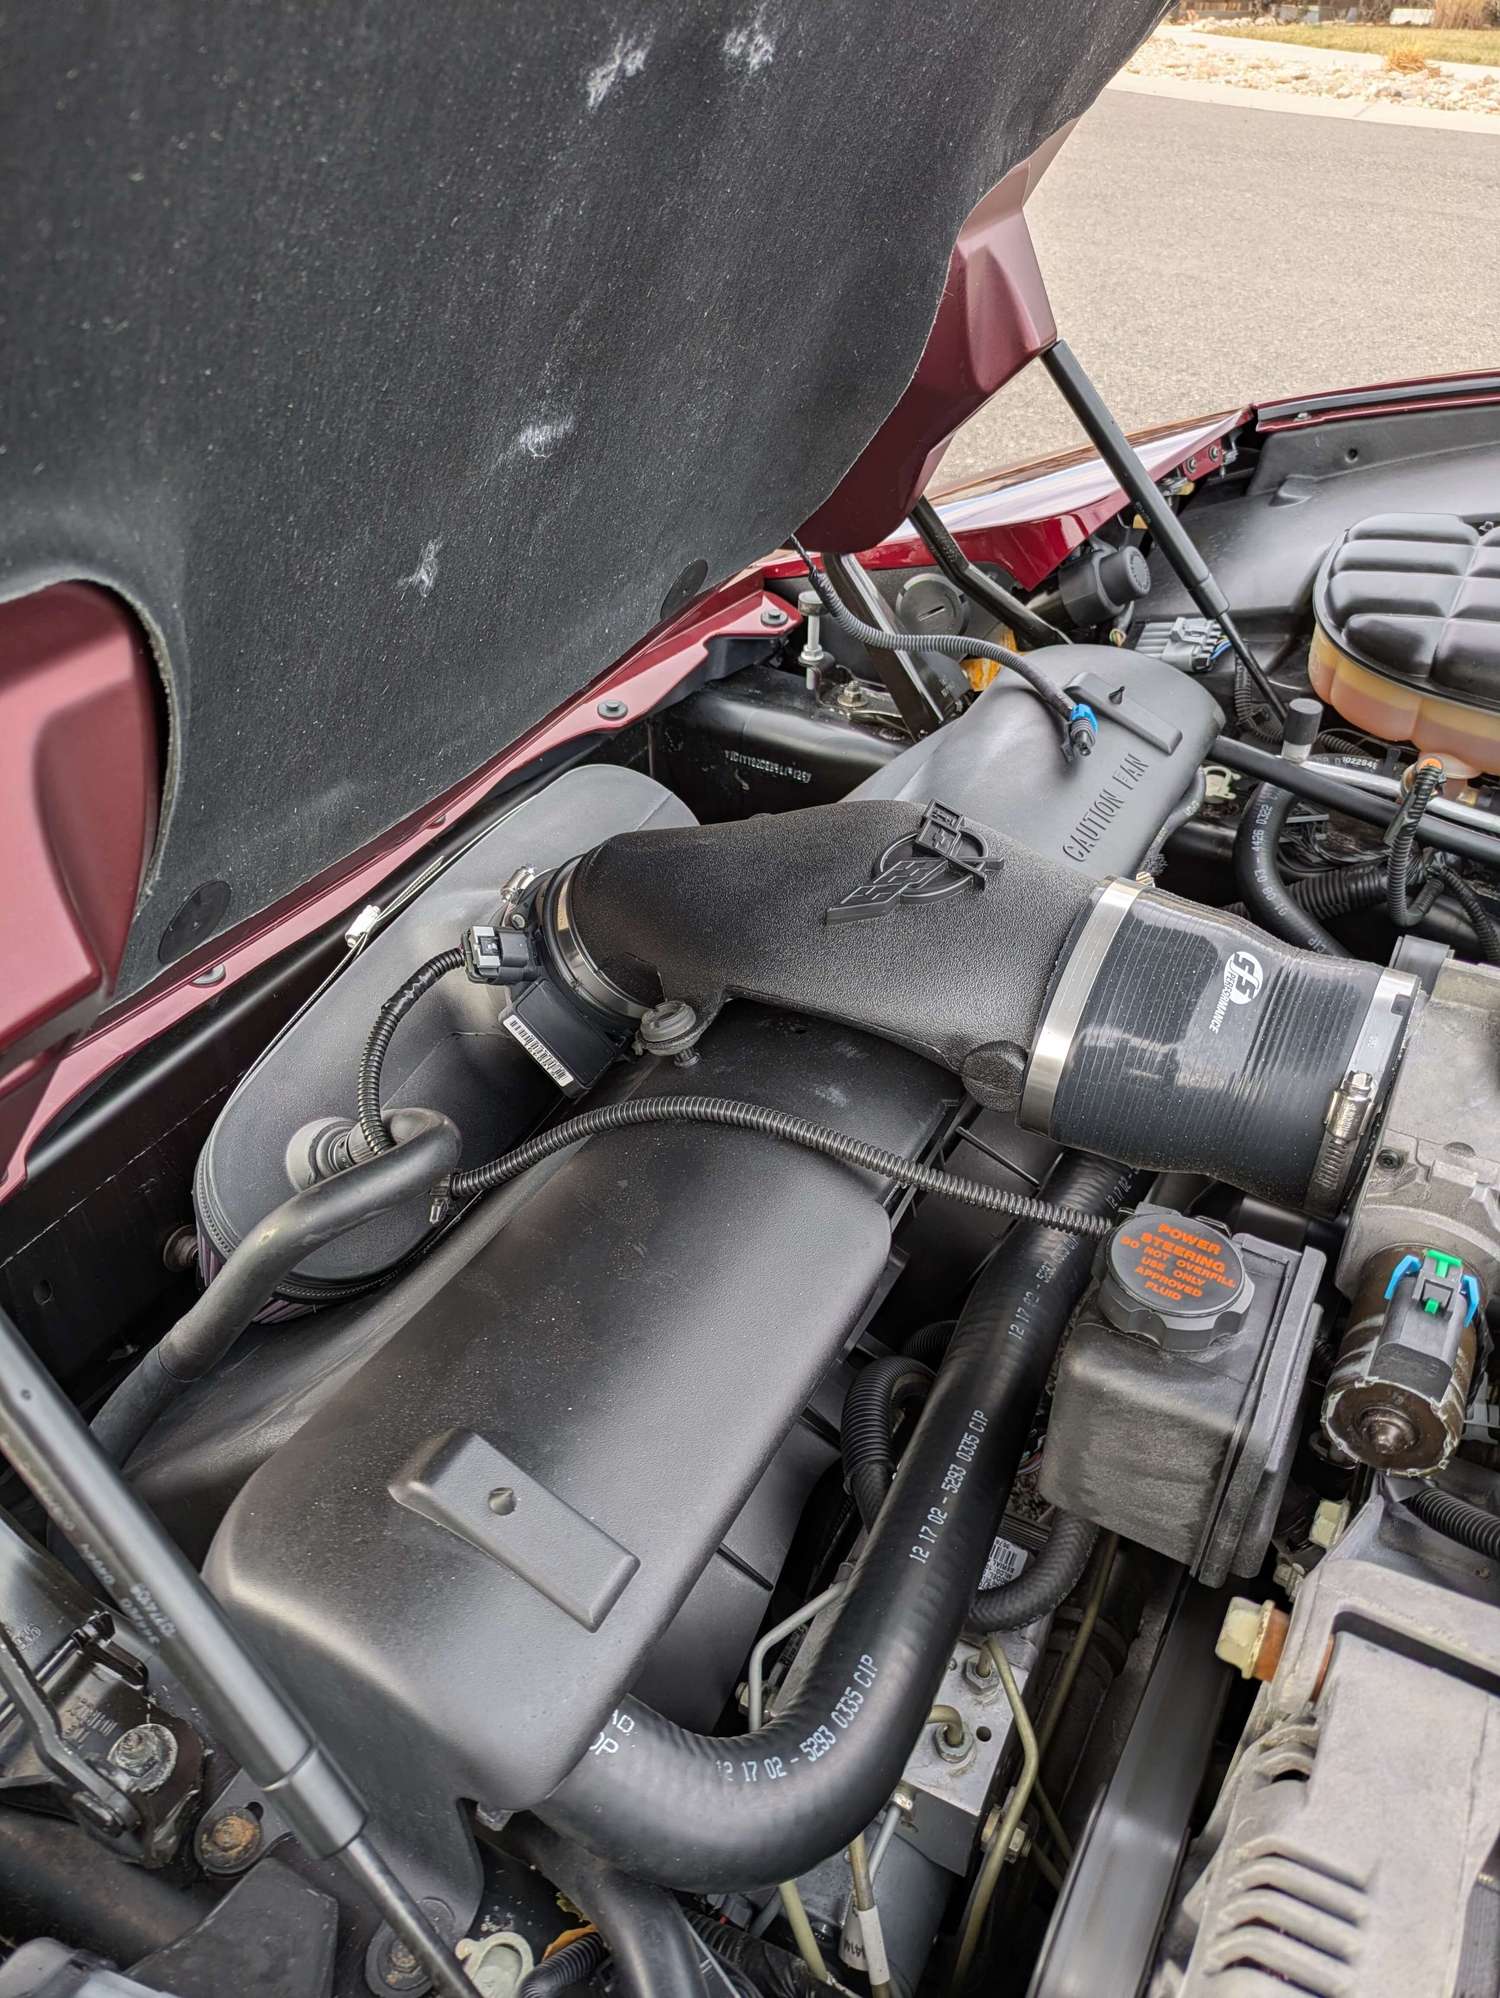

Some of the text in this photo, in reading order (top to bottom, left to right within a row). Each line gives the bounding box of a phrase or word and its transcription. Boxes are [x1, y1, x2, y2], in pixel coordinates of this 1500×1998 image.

[1062, 753, 1150, 862] CAUTION FAN
[1208, 970, 1237, 1034] PERFORMANCE
[1141, 1232, 1225, 1273] STEERING
[1158, 1223, 1222, 1255] POWER
[1120, 1235, 1236, 1289] DO NOT OVERFILL
[1141, 1256, 1206, 1287] USE ONLY
[1135, 1265, 1203, 1297] APPROVED
[1144, 1280, 1182, 1301] FLUID
[1015, 1306, 1032, 1324] 17
[1008, 1323, 1025, 1340] 12
[969, 1409, 989, 1433] CIP
[955, 1432, 980, 1462] 0335
[941, 1464, 967, 1494] 5293
[927, 1507, 948, 1525] 02
[918, 1525, 938, 1544] 17
[909, 1545, 930, 1564] 12
[742, 1760, 757, 1782] 17
[764, 1756, 787, 1780] 02
[800, 1725, 837, 1762] 5293
[831, 1687, 864, 1729] 0335
[853, 1654, 879, 1688] CIP
